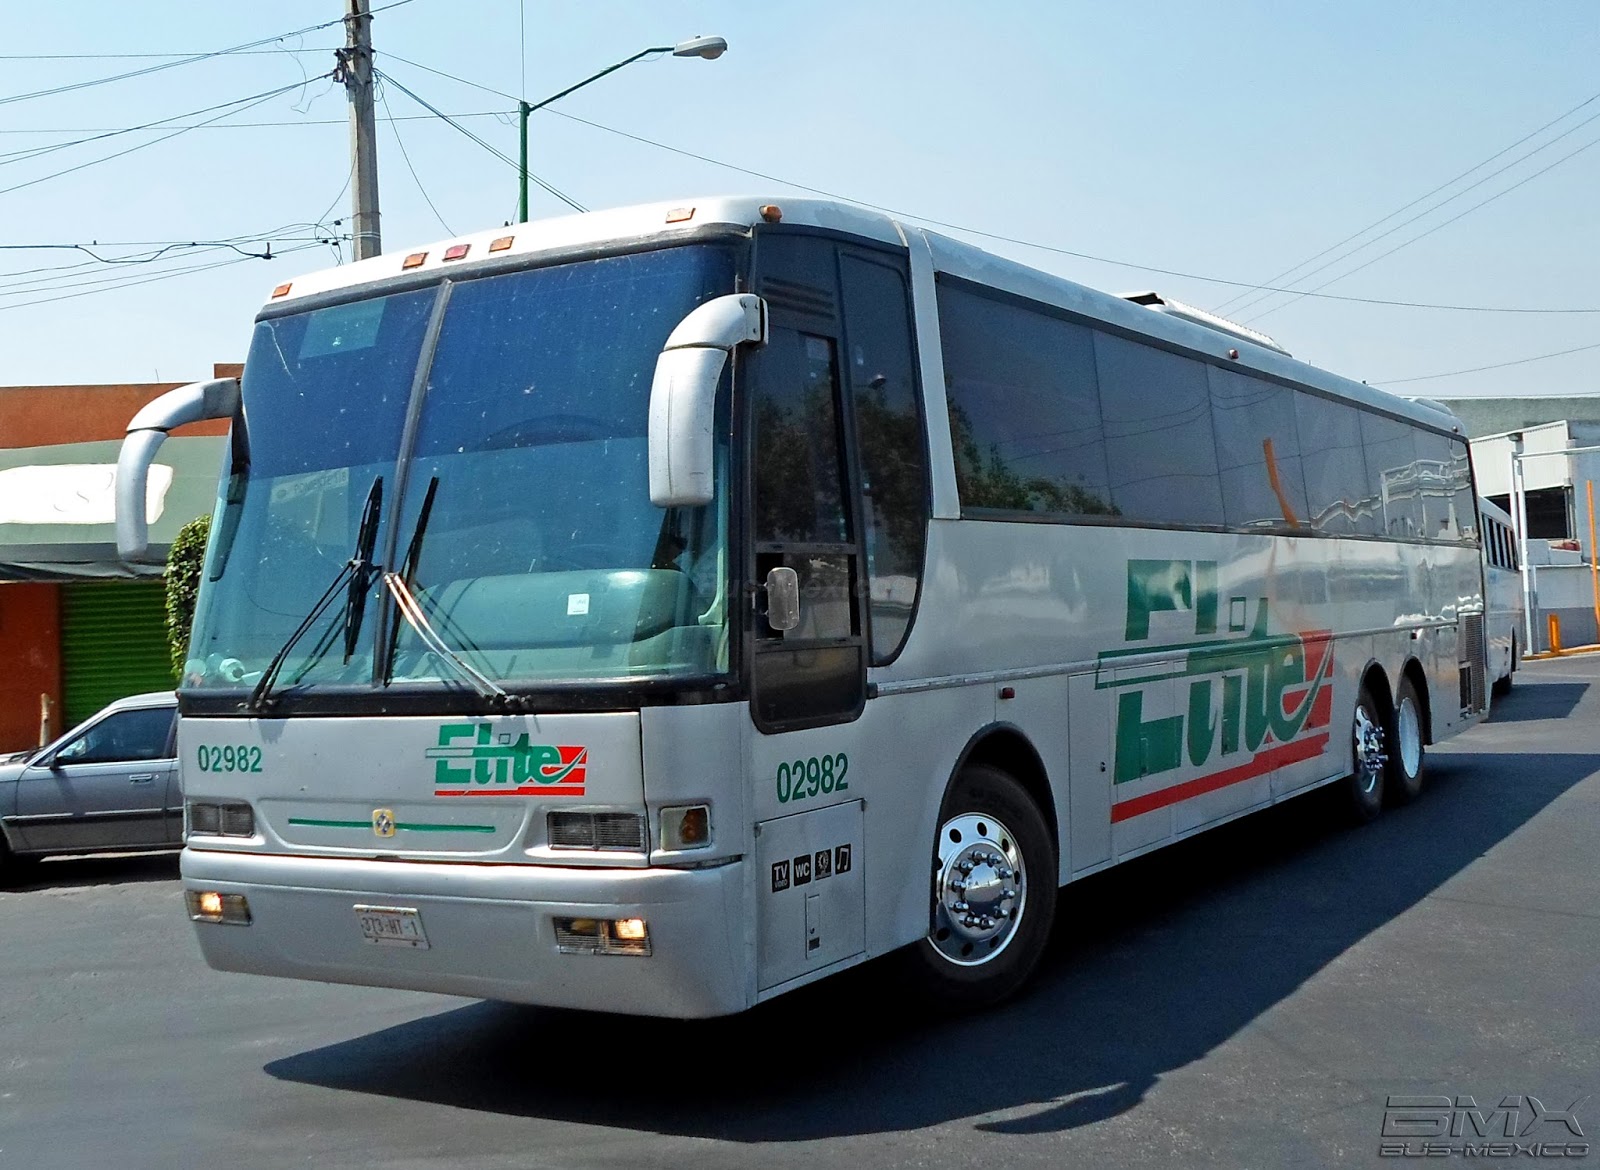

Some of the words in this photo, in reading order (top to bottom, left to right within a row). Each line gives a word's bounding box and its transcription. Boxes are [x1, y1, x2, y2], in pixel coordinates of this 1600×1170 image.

[1096, 559, 1335, 786] Elite
[198, 744, 263, 773] 02982
[427, 722, 587, 785] Elite
[776, 752, 849, 804] 02982
[773, 863, 788, 881] TV
[795, 862, 810, 878] WC
